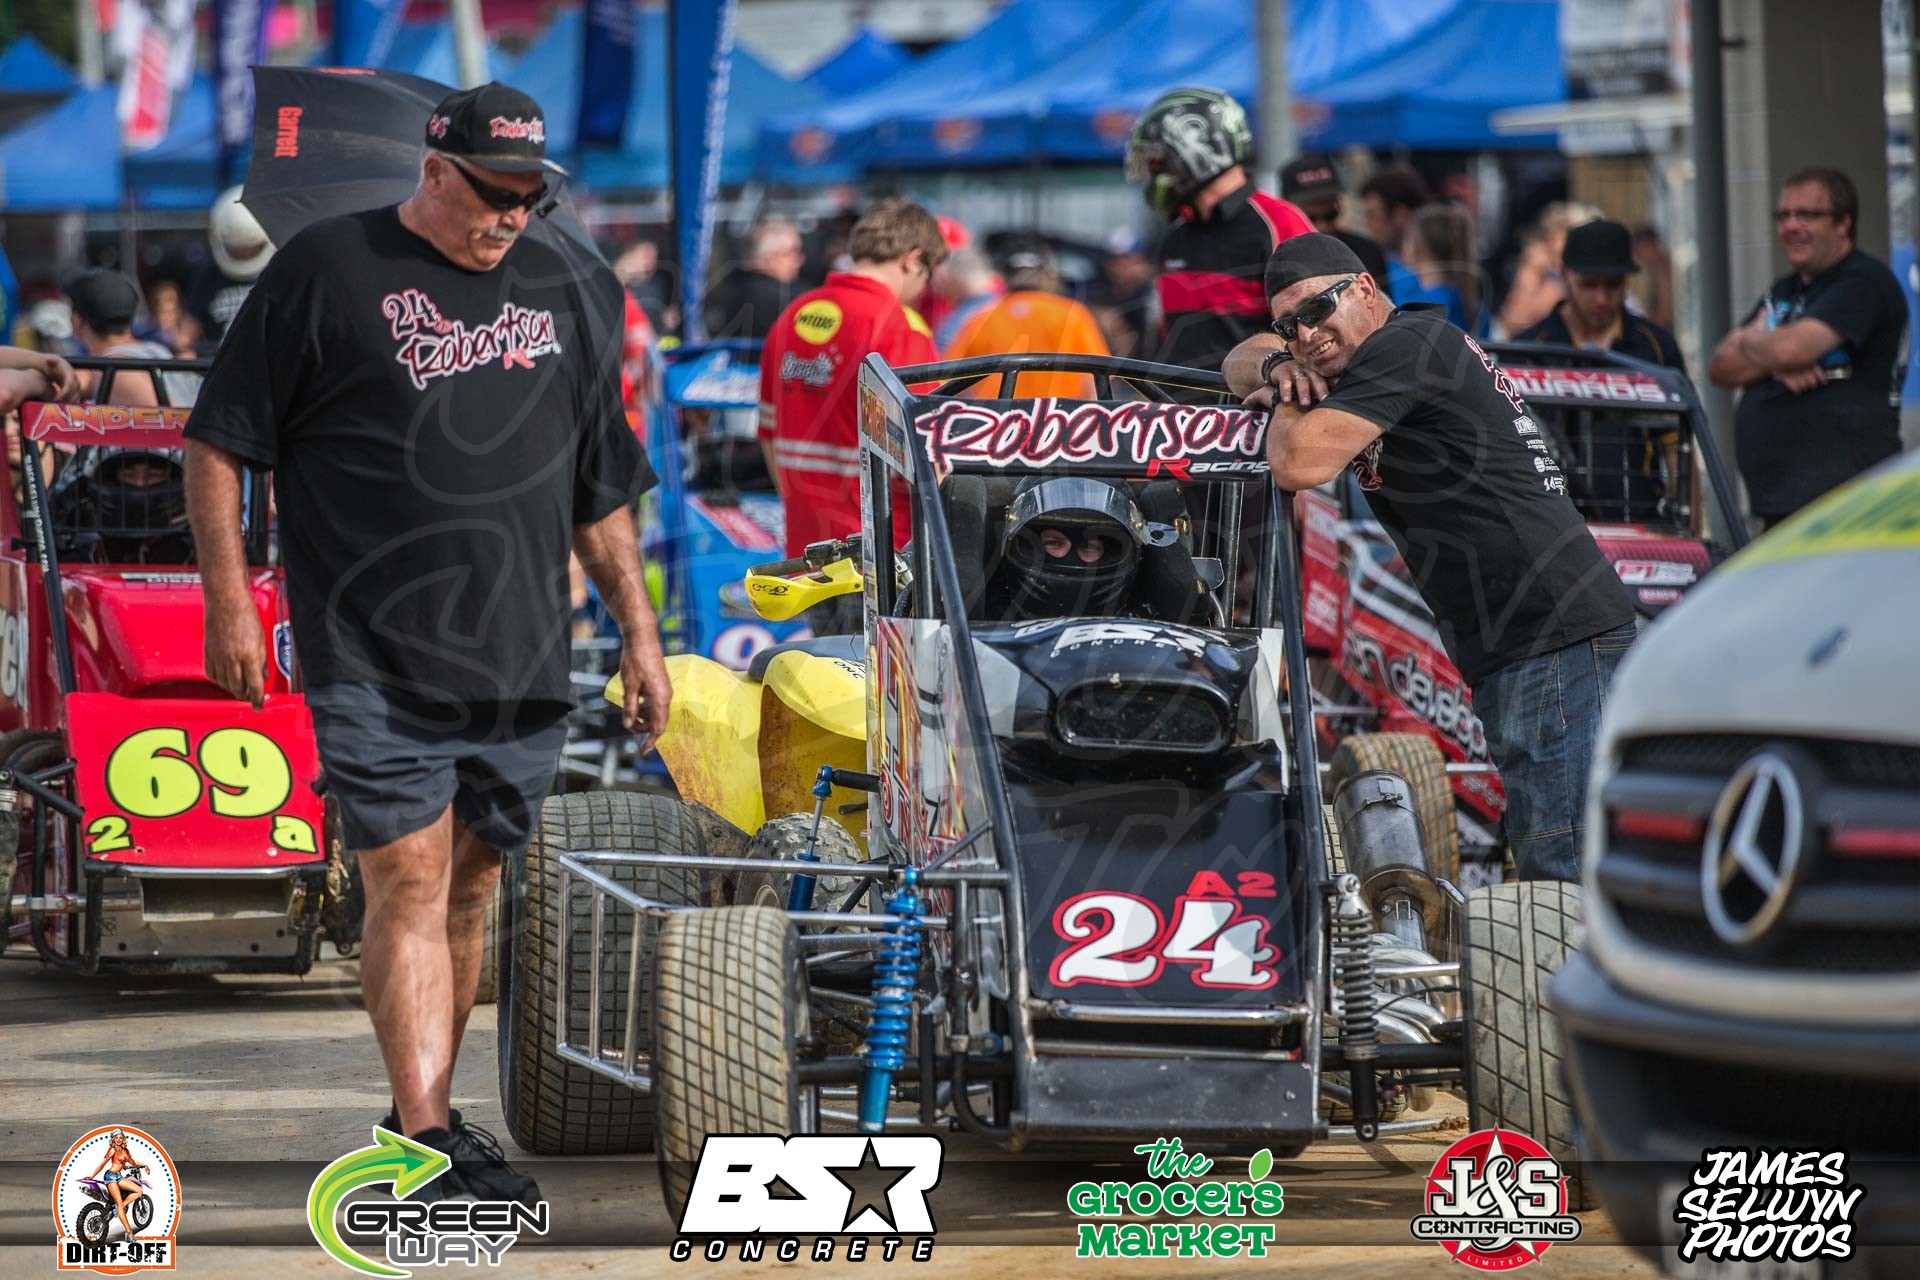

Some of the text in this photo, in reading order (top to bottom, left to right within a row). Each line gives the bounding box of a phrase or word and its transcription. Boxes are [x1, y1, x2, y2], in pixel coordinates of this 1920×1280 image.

[275, 106, 303, 158] Garrett
[382, 288, 439, 340] 24
[396, 302, 560, 391] Robertson
[1514, 376, 1668, 403] WARDS
[914, 397, 1267, 473] Robertson
[1146, 457, 1269, 481] Racing
[105, 727, 292, 818] 69
[87, 815, 133, 854] 2
[1186, 870, 1277, 898] A2
[1052, 890, 1282, 989] 24
